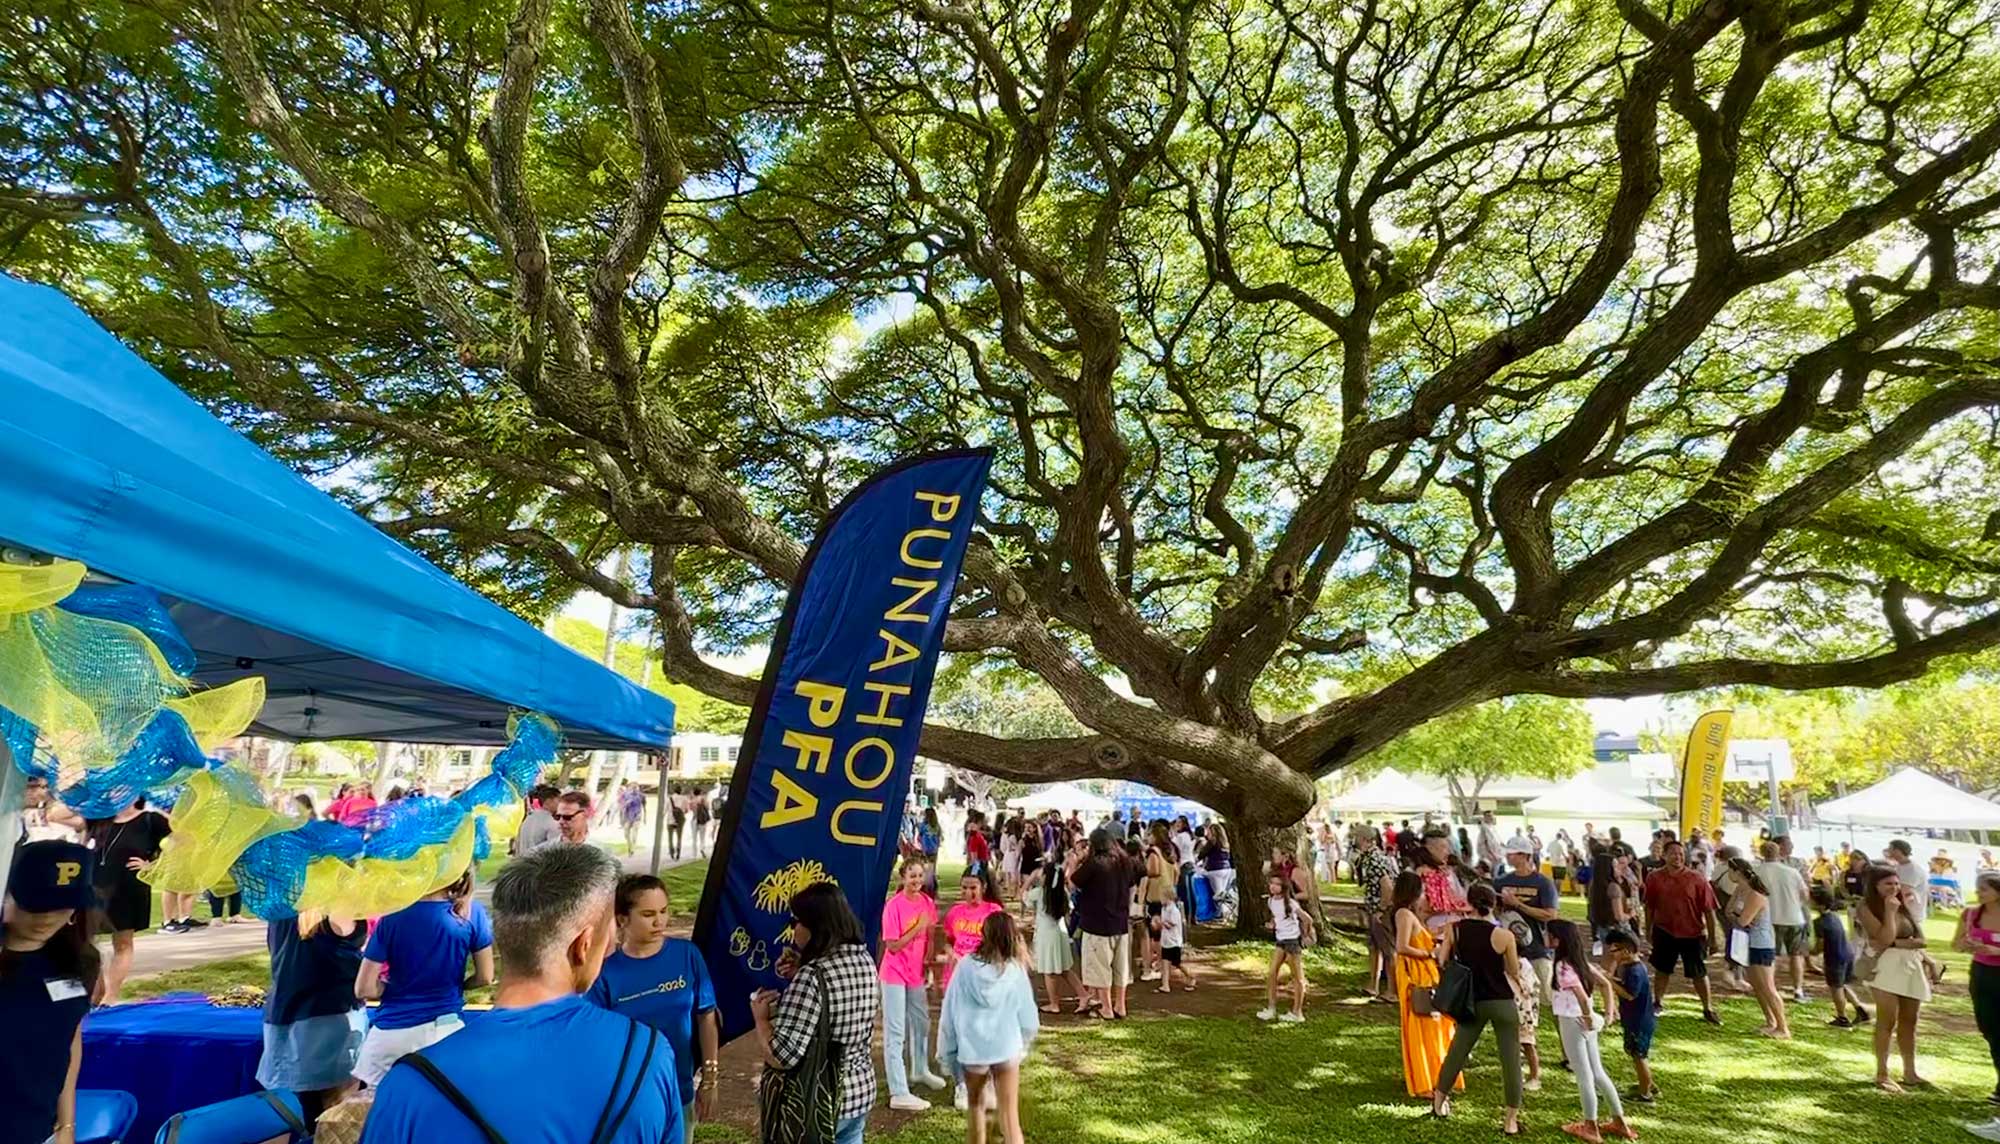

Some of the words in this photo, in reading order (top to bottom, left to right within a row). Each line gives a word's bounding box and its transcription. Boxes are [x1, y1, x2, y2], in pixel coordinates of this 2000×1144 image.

[830, 491, 961, 847] PUNAHOU
[1705, 722, 1722, 748] Buff
[759, 681, 847, 829] PFA
[1702, 763, 1716, 790] Blue
[56, 862, 81, 886] P
[658, 975, 687, 993] 2026
